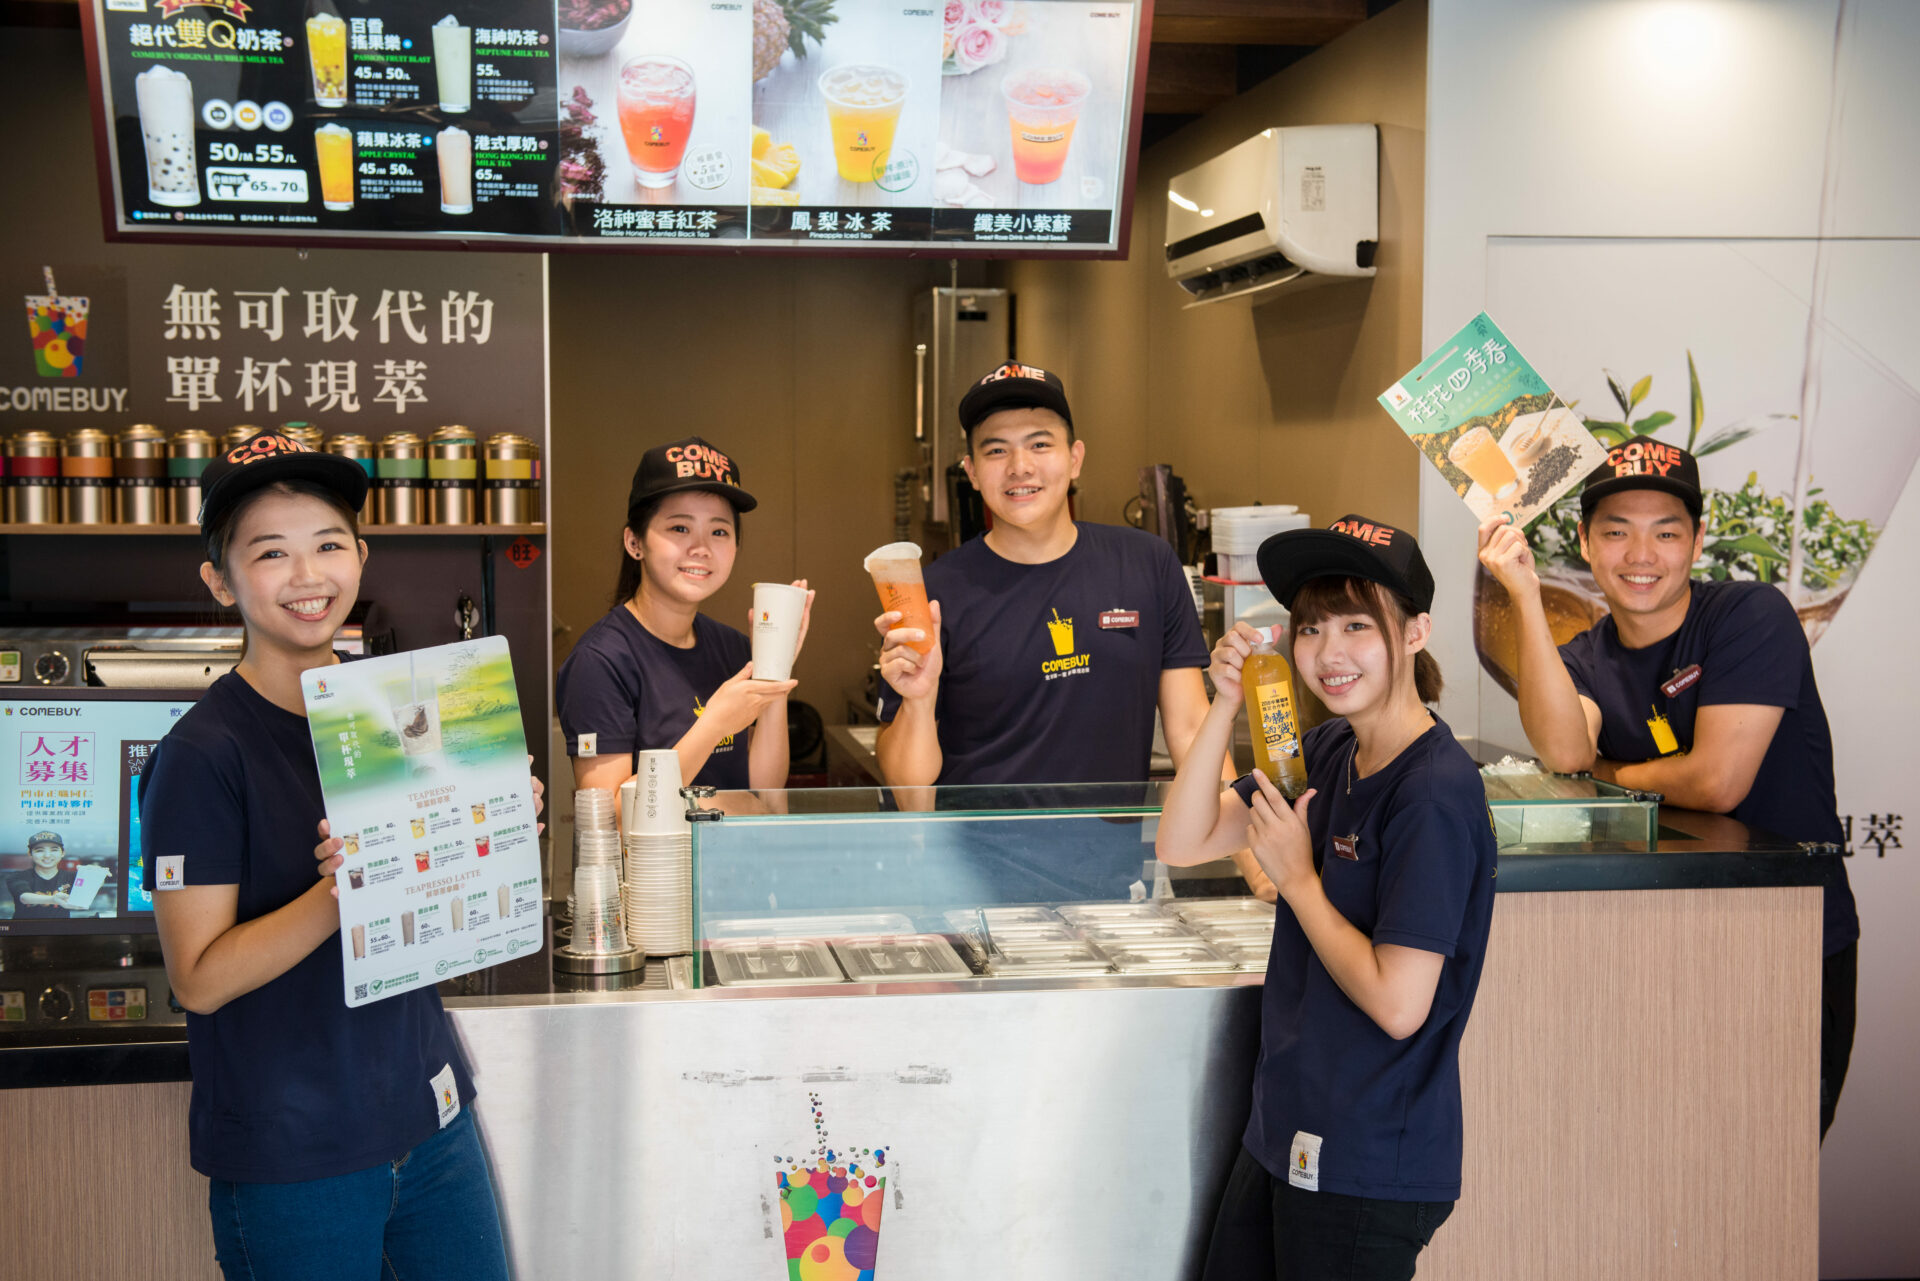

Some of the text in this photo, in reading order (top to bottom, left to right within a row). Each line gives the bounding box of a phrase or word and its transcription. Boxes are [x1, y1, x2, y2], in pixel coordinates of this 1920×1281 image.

[129, 18, 283, 51] 絕代雙Q奶茶
[475, 28, 539, 46] 海神奶茶
[131, 51, 284, 64] COMEBUY ORIGINAL BUBBLE MILK TEA
[475, 48, 549, 58] NEPTUNE MILK TEA
[357, 131, 421, 149] 蘋果冰茶
[475, 135, 538, 151] 港式厚奶
[209, 142, 297, 164] 50/M 55/L
[383, 151, 416, 159] CRYSTAL
[593, 209, 717, 230] 洛神蜜香紅茶
[790, 211, 893, 232] 鳳梨冰茶
[973, 213, 1072, 233] 纖美小紫蘇
[625, 229, 647, 237] Honey
[163, 284, 494, 345] 無可取代的
[165, 355, 429, 414] 單杯現萃
[1407, 338, 1509, 425] 桂花四季春
[0, 386, 128, 412] COMEBUY
[665, 444, 730, 471] COME
[1607, 442, 1682, 467] COME
[676, 461, 725, 482] BUY
[1615, 459, 1672, 478] BUY
[512, 543, 533, 562] 旺
[1110, 616, 1136, 624] COMEBUY
[1042, 653, 1090, 673] COMEBUY
[20, 707, 81, 716] COMEBUY
[27, 735, 89, 757] 人才
[26, 760, 89, 783] 募集
[408, 784, 456, 802] TEAPRESSO
[404, 876, 448, 896] TEAPRESSO
[449, 869, 481, 885] LATTE
[1292, 1168, 1314, 1180] COMEBUY
